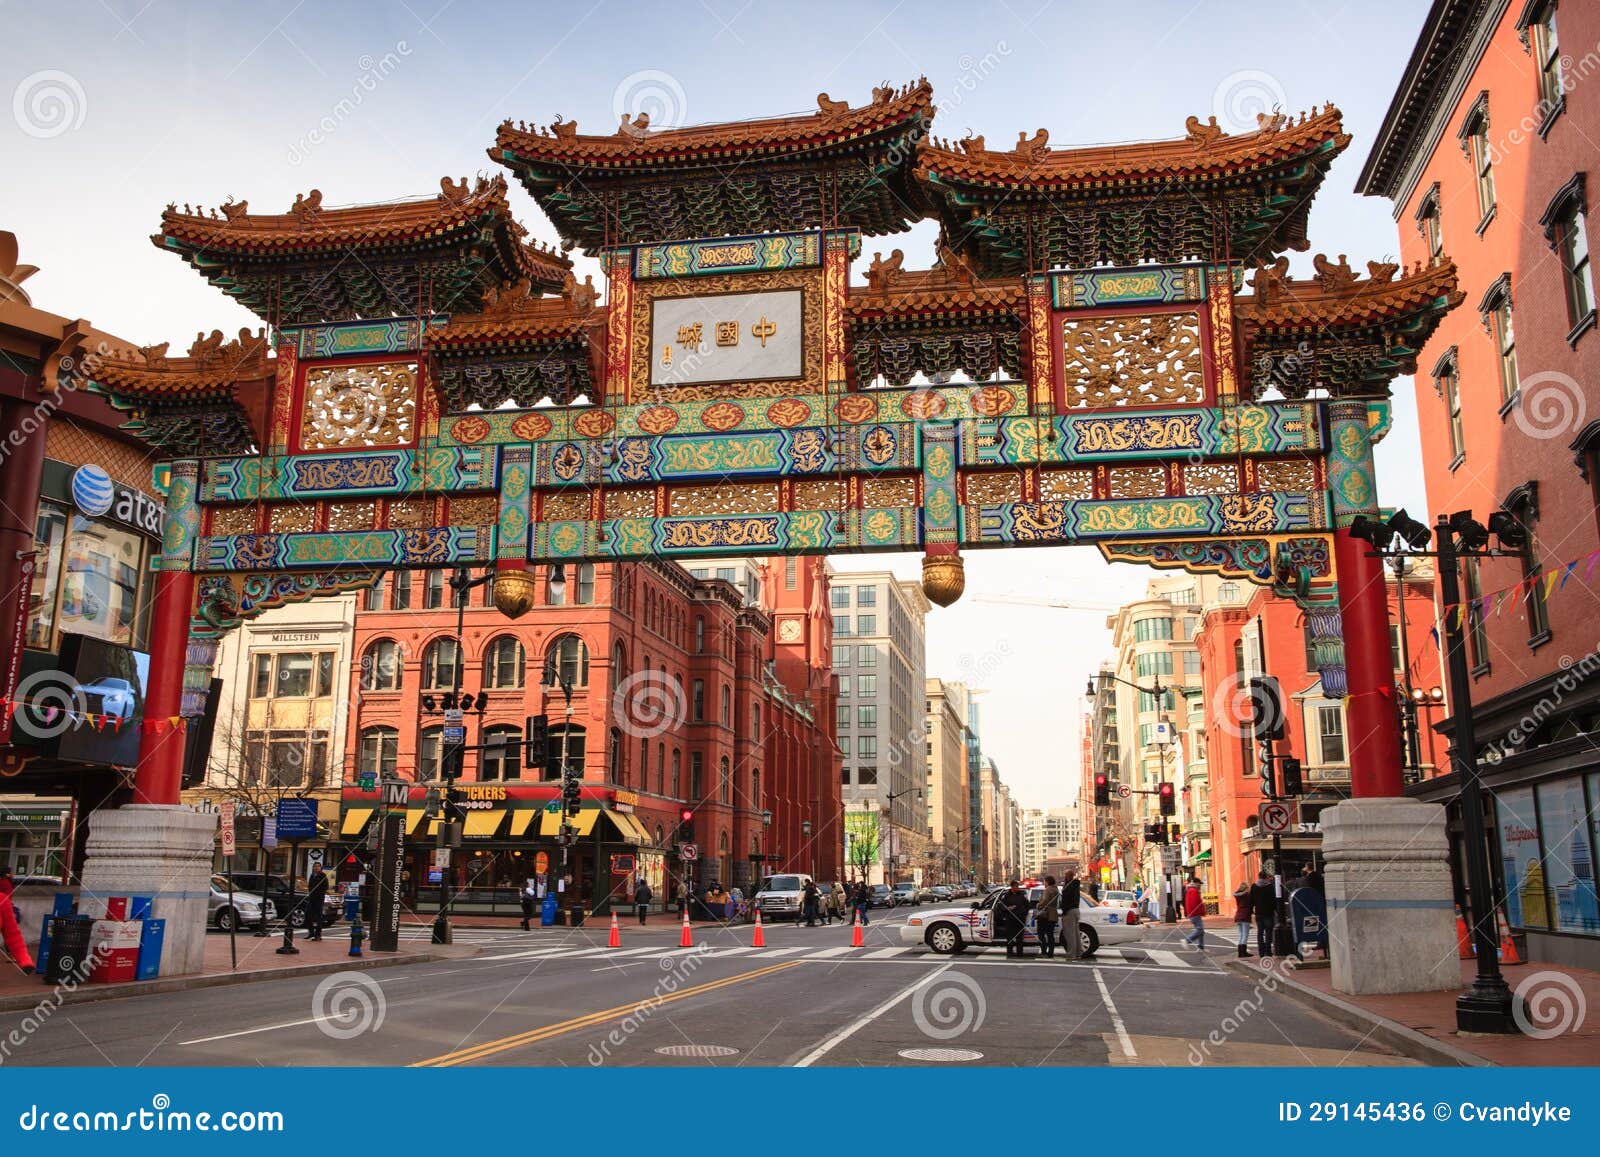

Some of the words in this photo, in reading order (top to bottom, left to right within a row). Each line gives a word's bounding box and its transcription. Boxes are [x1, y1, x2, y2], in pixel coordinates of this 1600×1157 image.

[115, 488, 165, 536] at&t
[271, 633, 320, 643] MILLSTEIN
[389, 785, 408, 804] M
[397, 818, 406, 849] Gallery
[391, 902, 401, 932] Station
